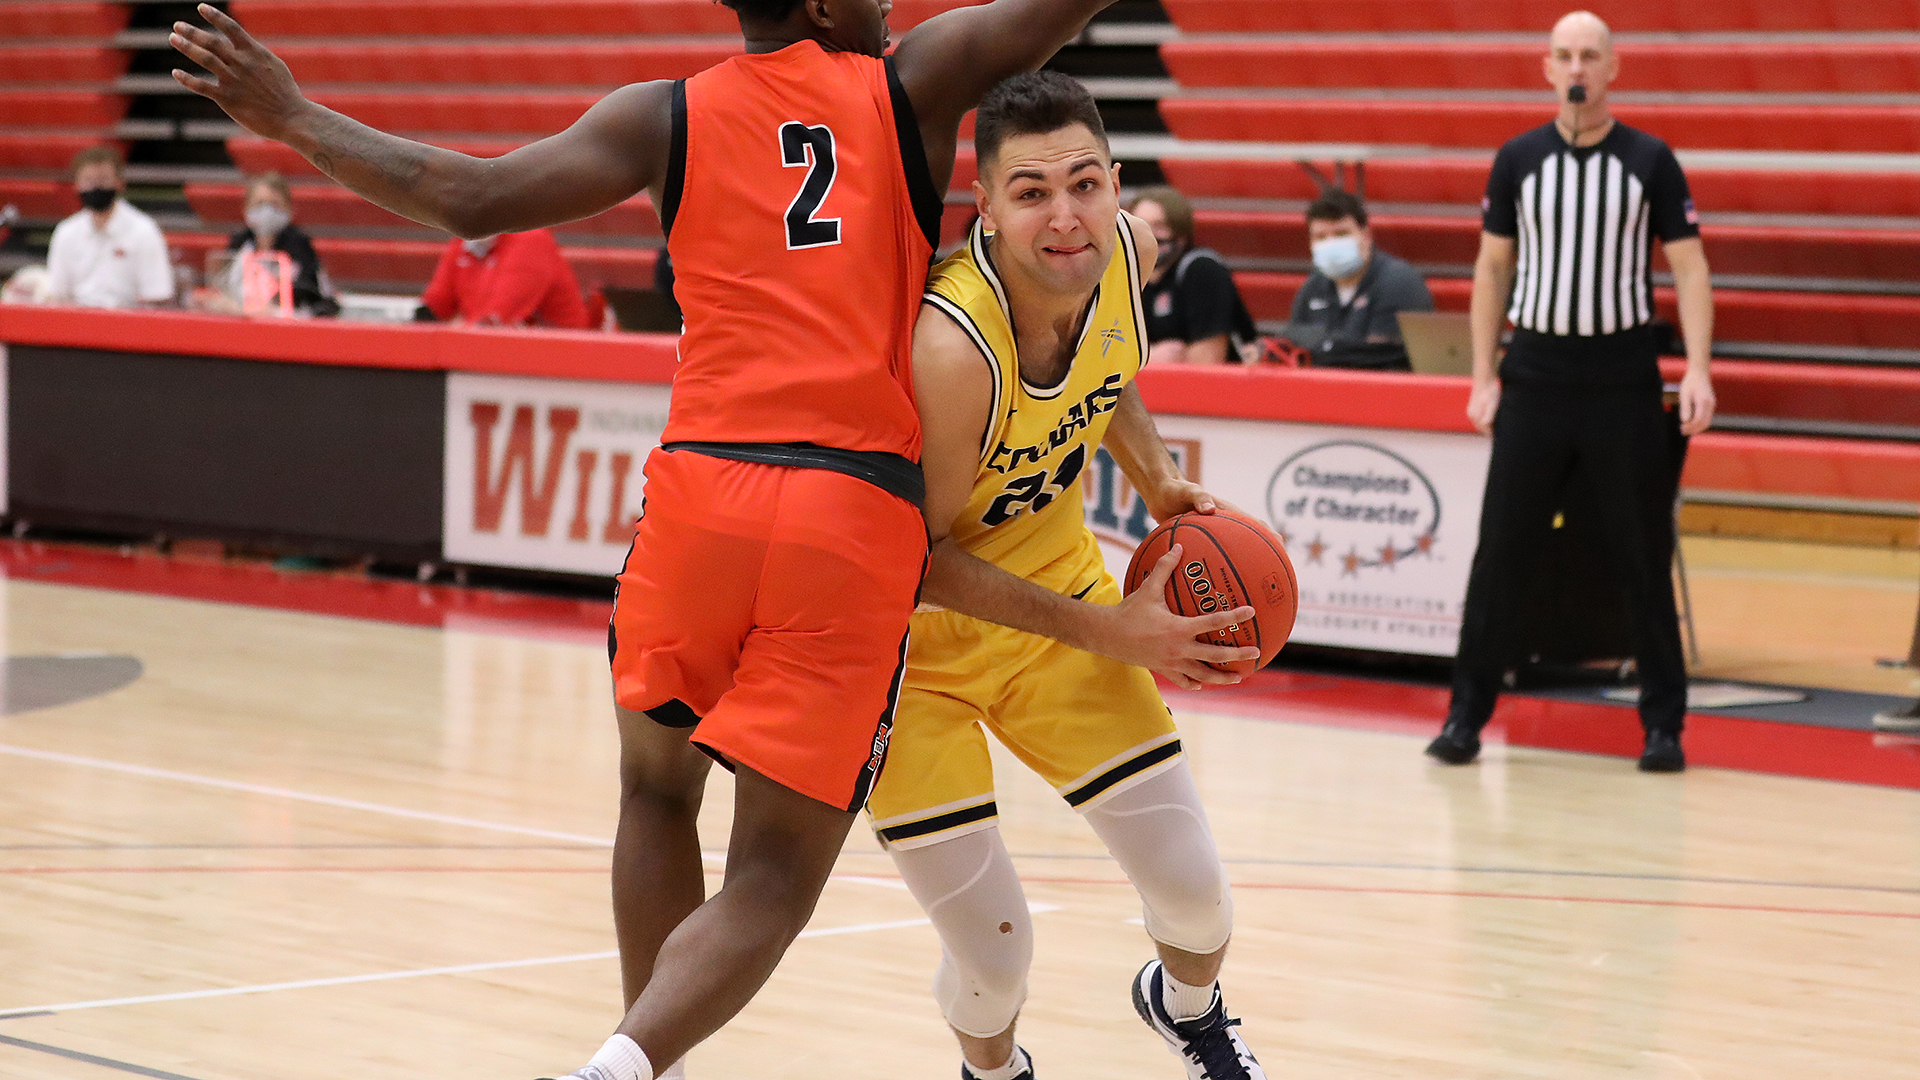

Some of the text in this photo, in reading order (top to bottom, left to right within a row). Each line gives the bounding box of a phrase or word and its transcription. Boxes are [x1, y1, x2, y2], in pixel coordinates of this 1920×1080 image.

[778, 120, 842, 250] 2
[469, 401, 642, 544] WIL
[1285, 496, 1419, 525] of Character
[1293, 465, 1410, 495] Champions
